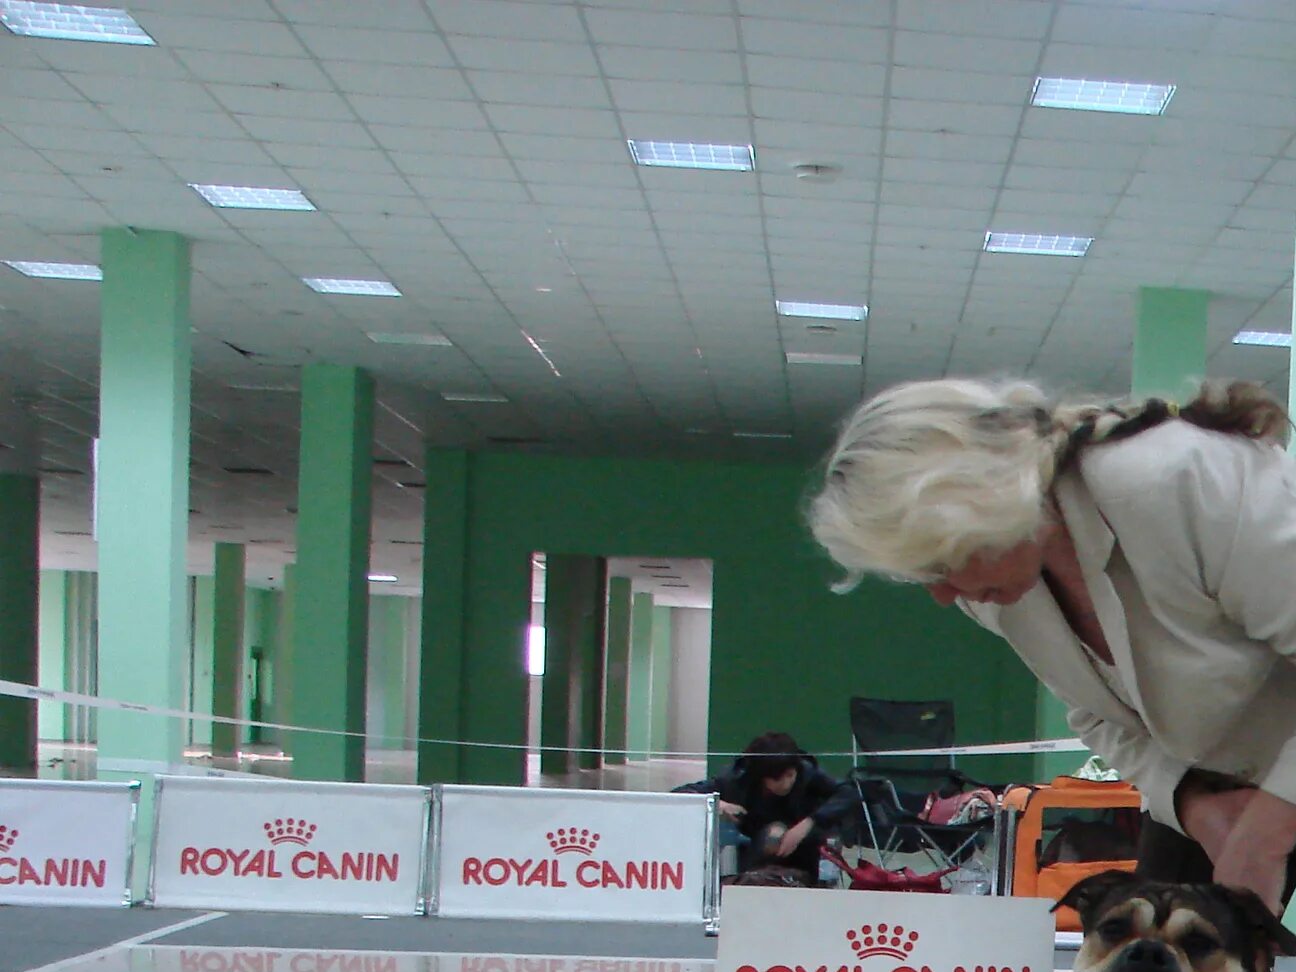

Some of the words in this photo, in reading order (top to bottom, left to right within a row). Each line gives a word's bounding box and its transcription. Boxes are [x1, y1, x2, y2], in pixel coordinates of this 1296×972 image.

[0, 857, 106, 888] CANIN
[180, 847, 283, 879] ROYAL
[291, 850, 399, 882] CANIN
[462, 857, 567, 888] ROYAL
[576, 859, 684, 891] CANIN
